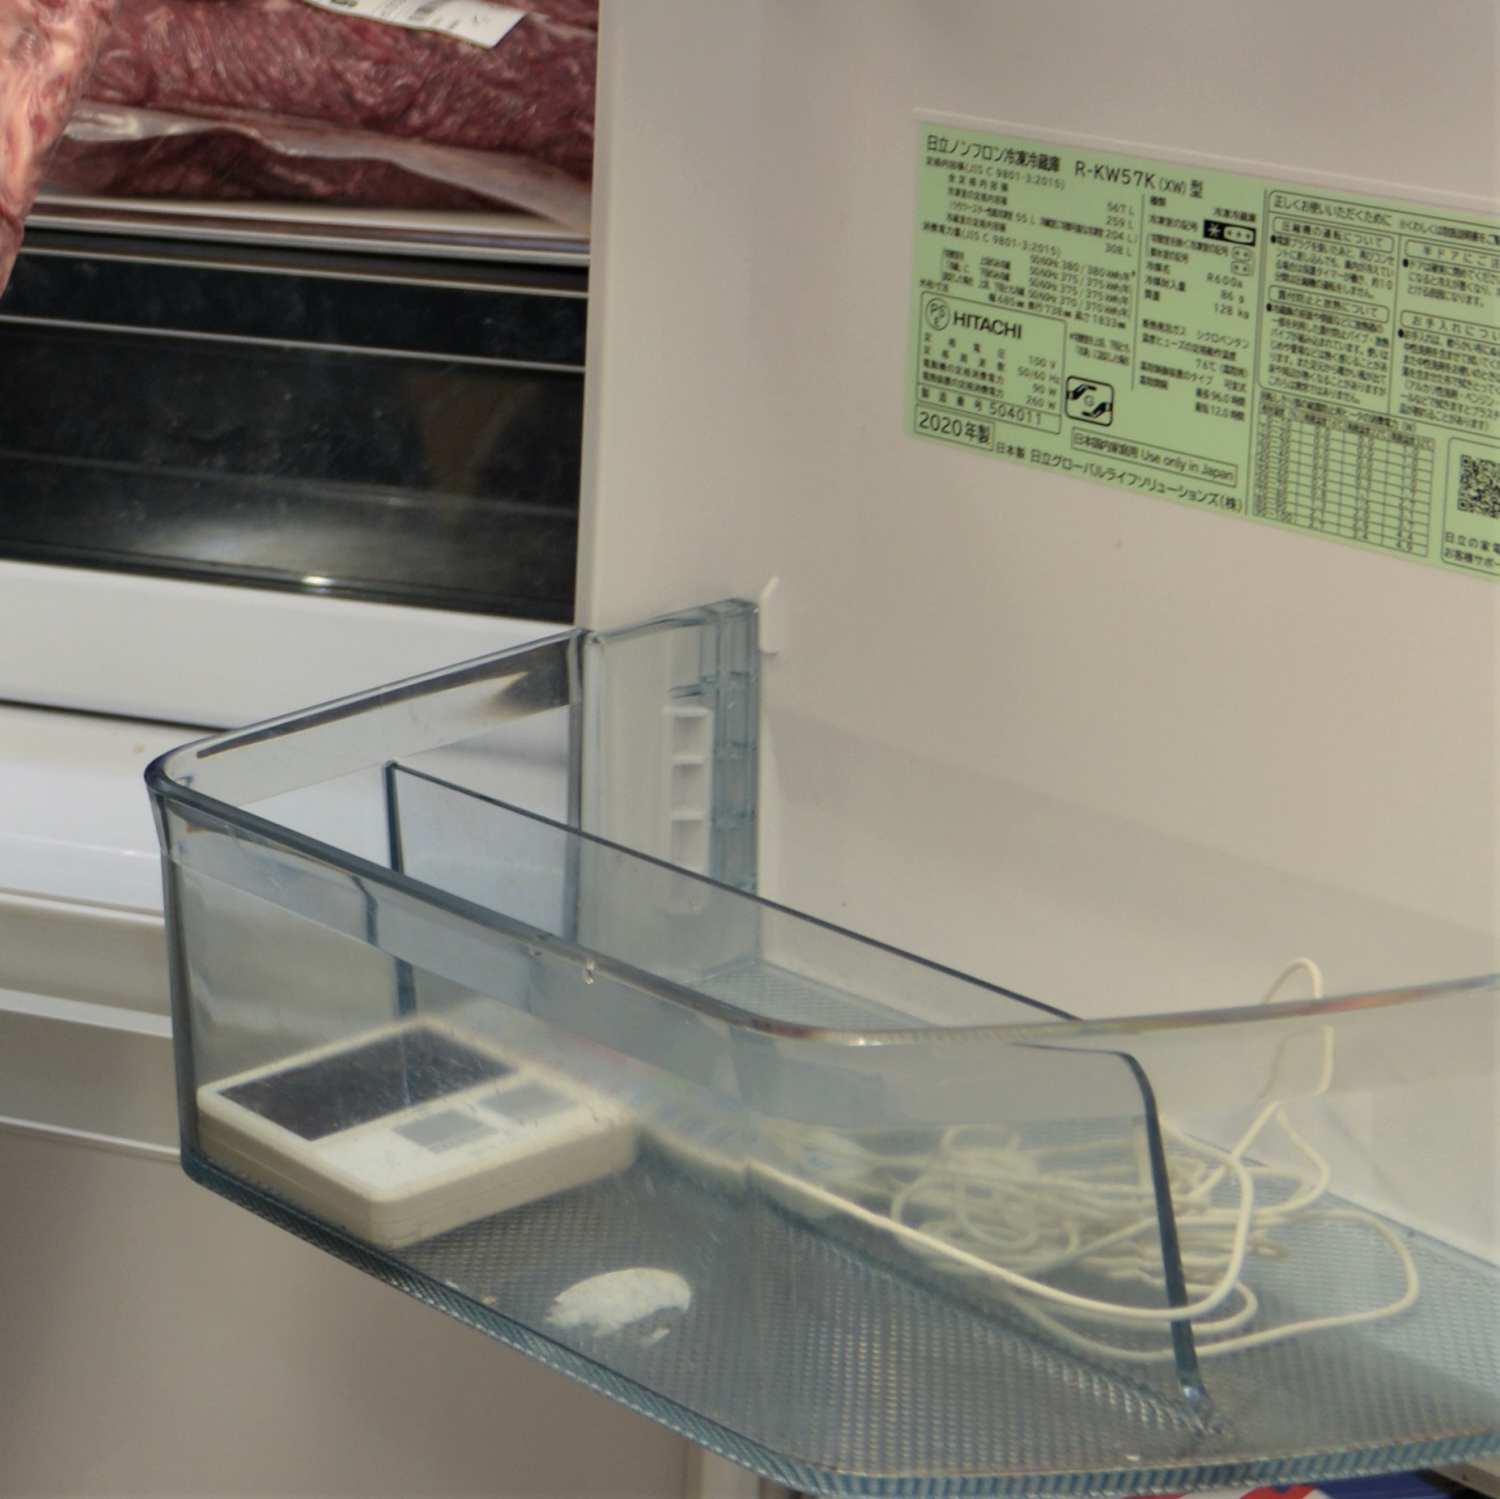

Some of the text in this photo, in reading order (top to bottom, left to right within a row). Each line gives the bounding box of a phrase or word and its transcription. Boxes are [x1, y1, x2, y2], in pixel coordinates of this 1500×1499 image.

[927, 134, 1060, 172] 日立ノンフロン冷凍冷蔵庫
[953, 310, 1022, 339] HITACHI
[918, 410, 989, 443] 2020年製
[988, 401, 1041, 425] 504011
[996, 441, 1025, 458] 日本製
[1140, 448, 1161, 464] Use
[1162, 456, 1186, 473] only
[1196, 463, 1234, 487] Japan
